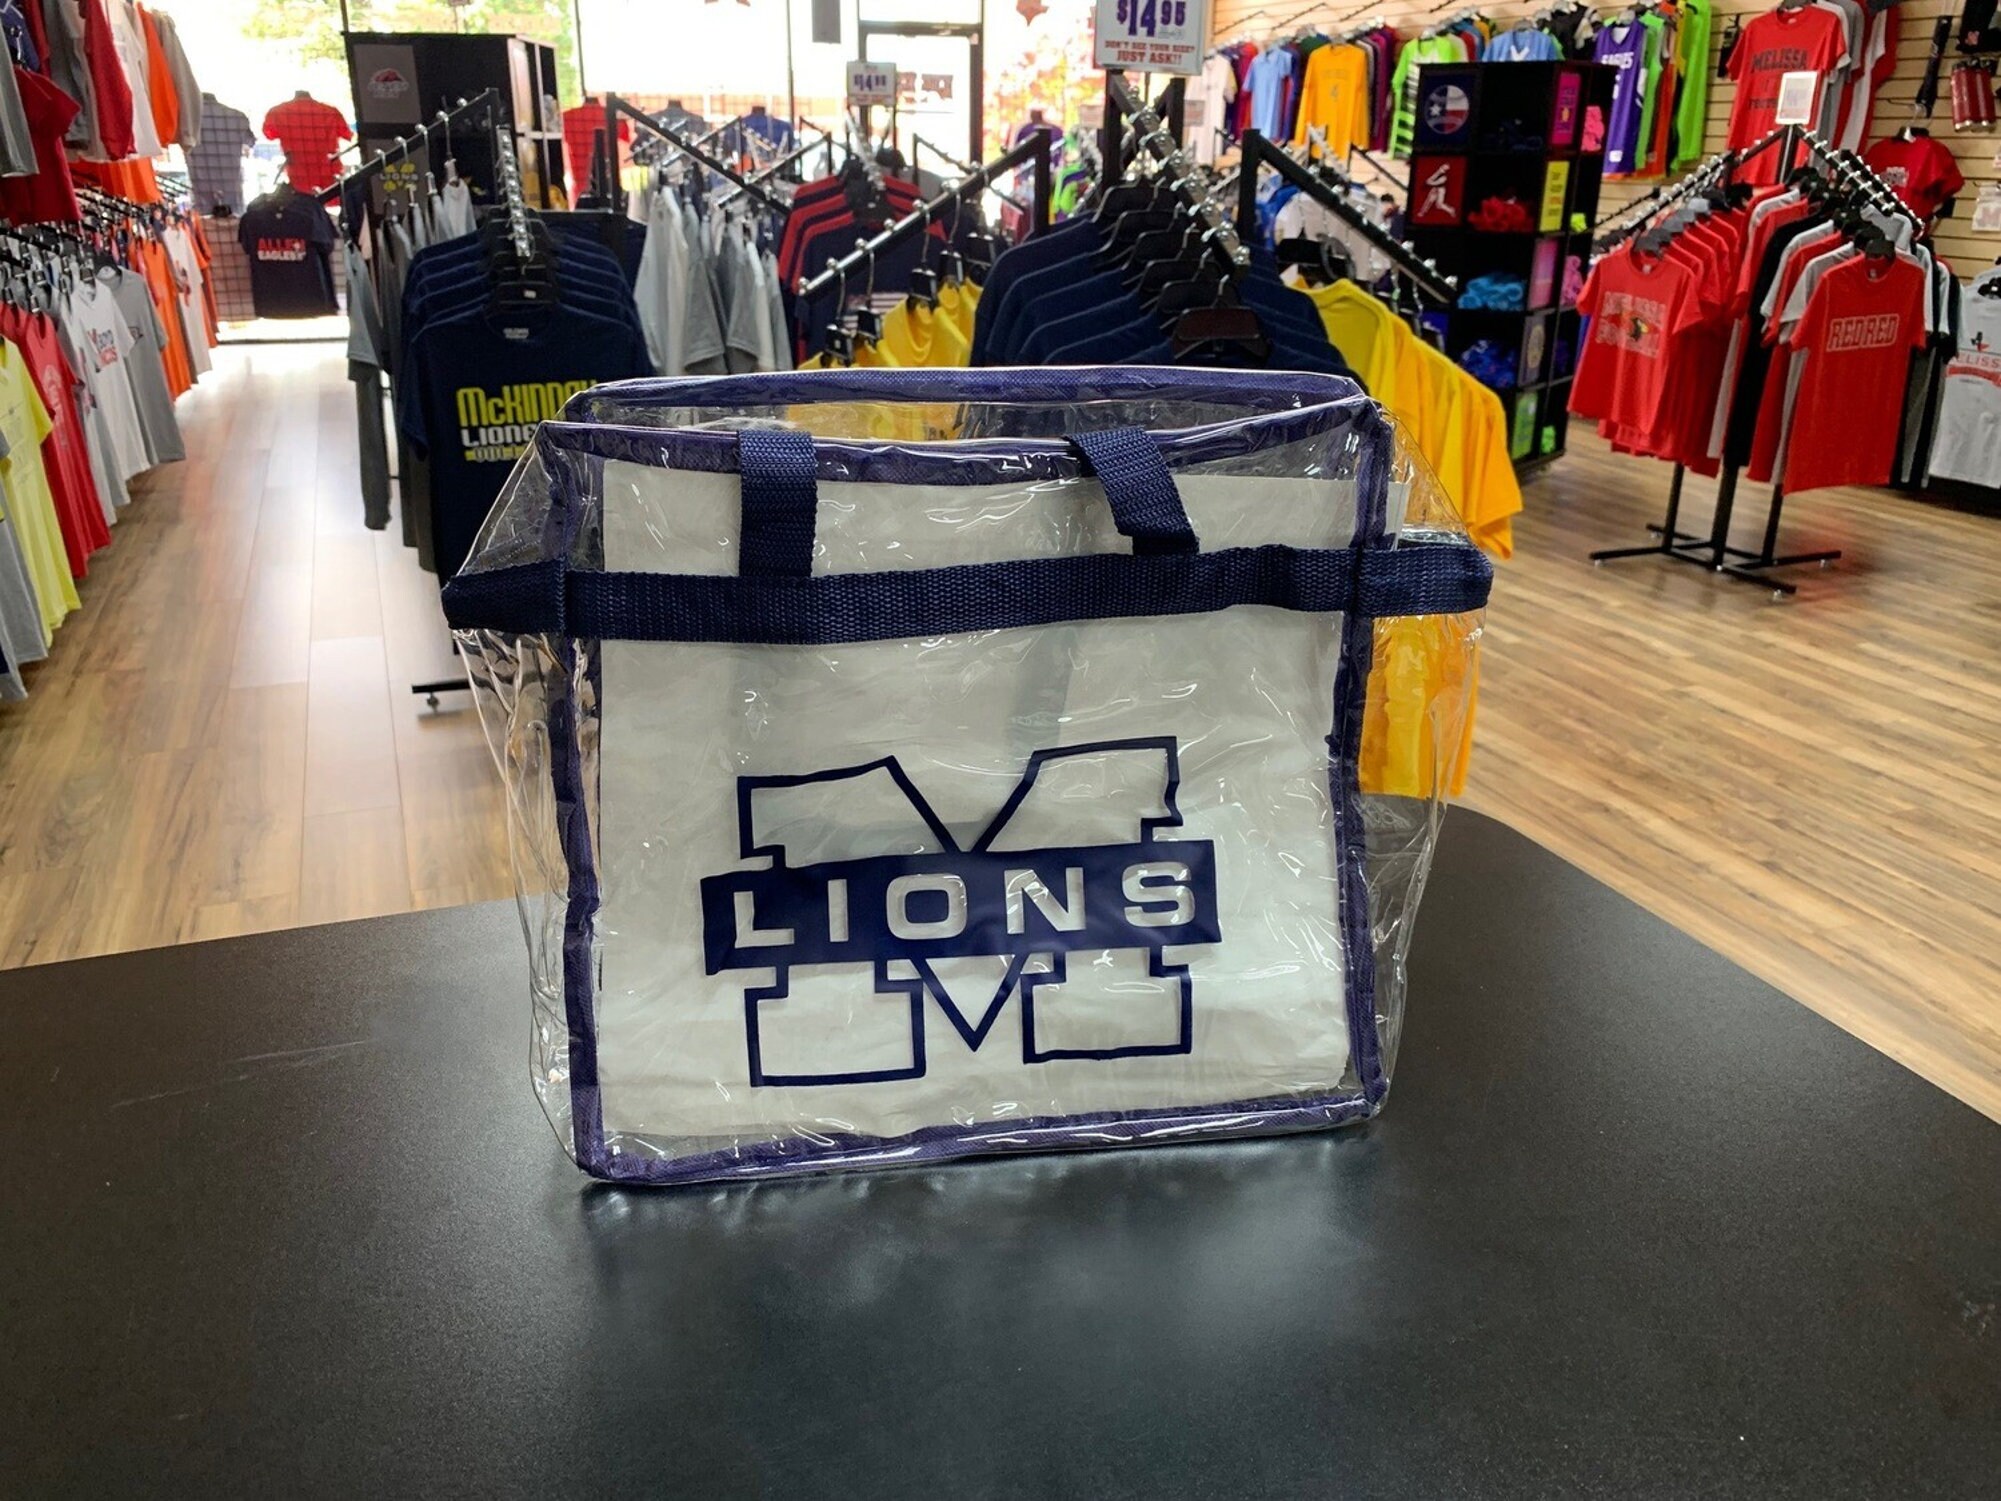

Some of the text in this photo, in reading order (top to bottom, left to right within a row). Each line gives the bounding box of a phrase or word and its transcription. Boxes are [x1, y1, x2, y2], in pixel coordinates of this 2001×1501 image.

[1117, 50, 1146, 62] JUST
[1132, 42, 1147, 50] SEE
[1149, 43, 1170, 52] YOUR
[1751, 46, 1809, 71] MELISSA
[257, 238, 306, 252] ALLEN
[456, 380, 598, 427] McKINN
[734, 861, 1195, 948] LIONS
